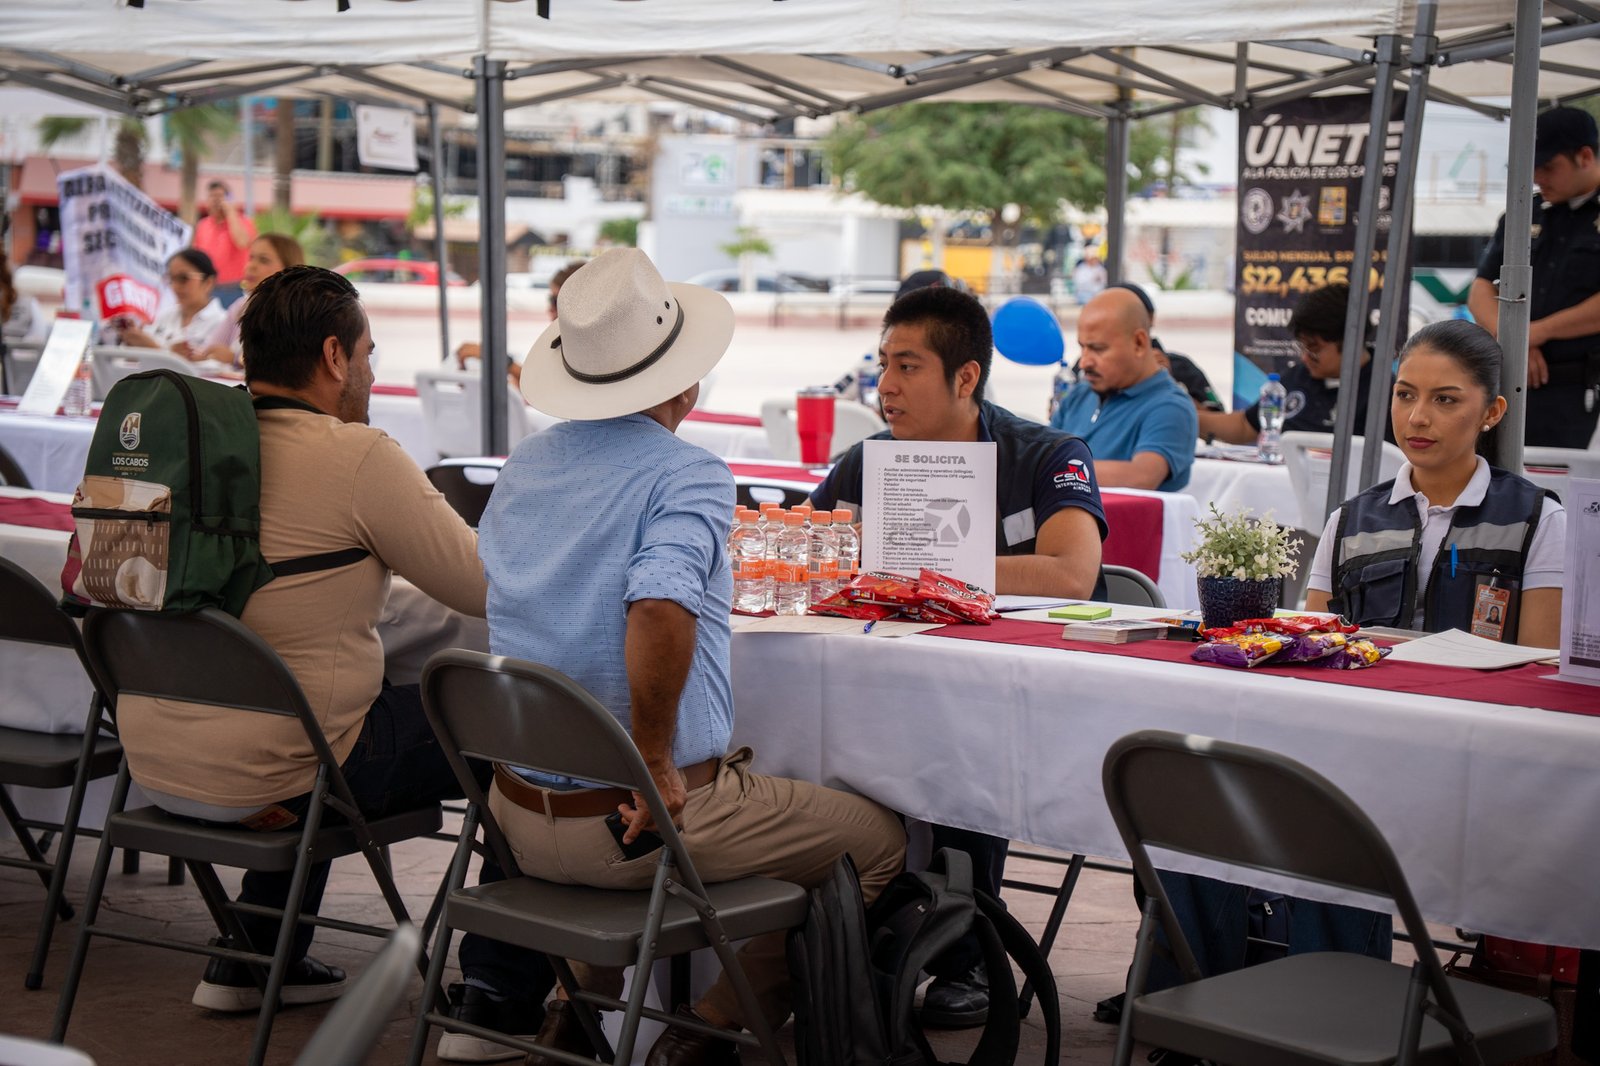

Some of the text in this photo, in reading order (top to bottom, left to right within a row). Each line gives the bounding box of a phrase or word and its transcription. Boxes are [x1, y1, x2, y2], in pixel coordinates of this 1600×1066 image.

[1245, 114, 1404, 167] ÚNETE
[112, 456, 149, 467] LOS CABOS
[895, 454, 966, 464] SE SOLICITA
